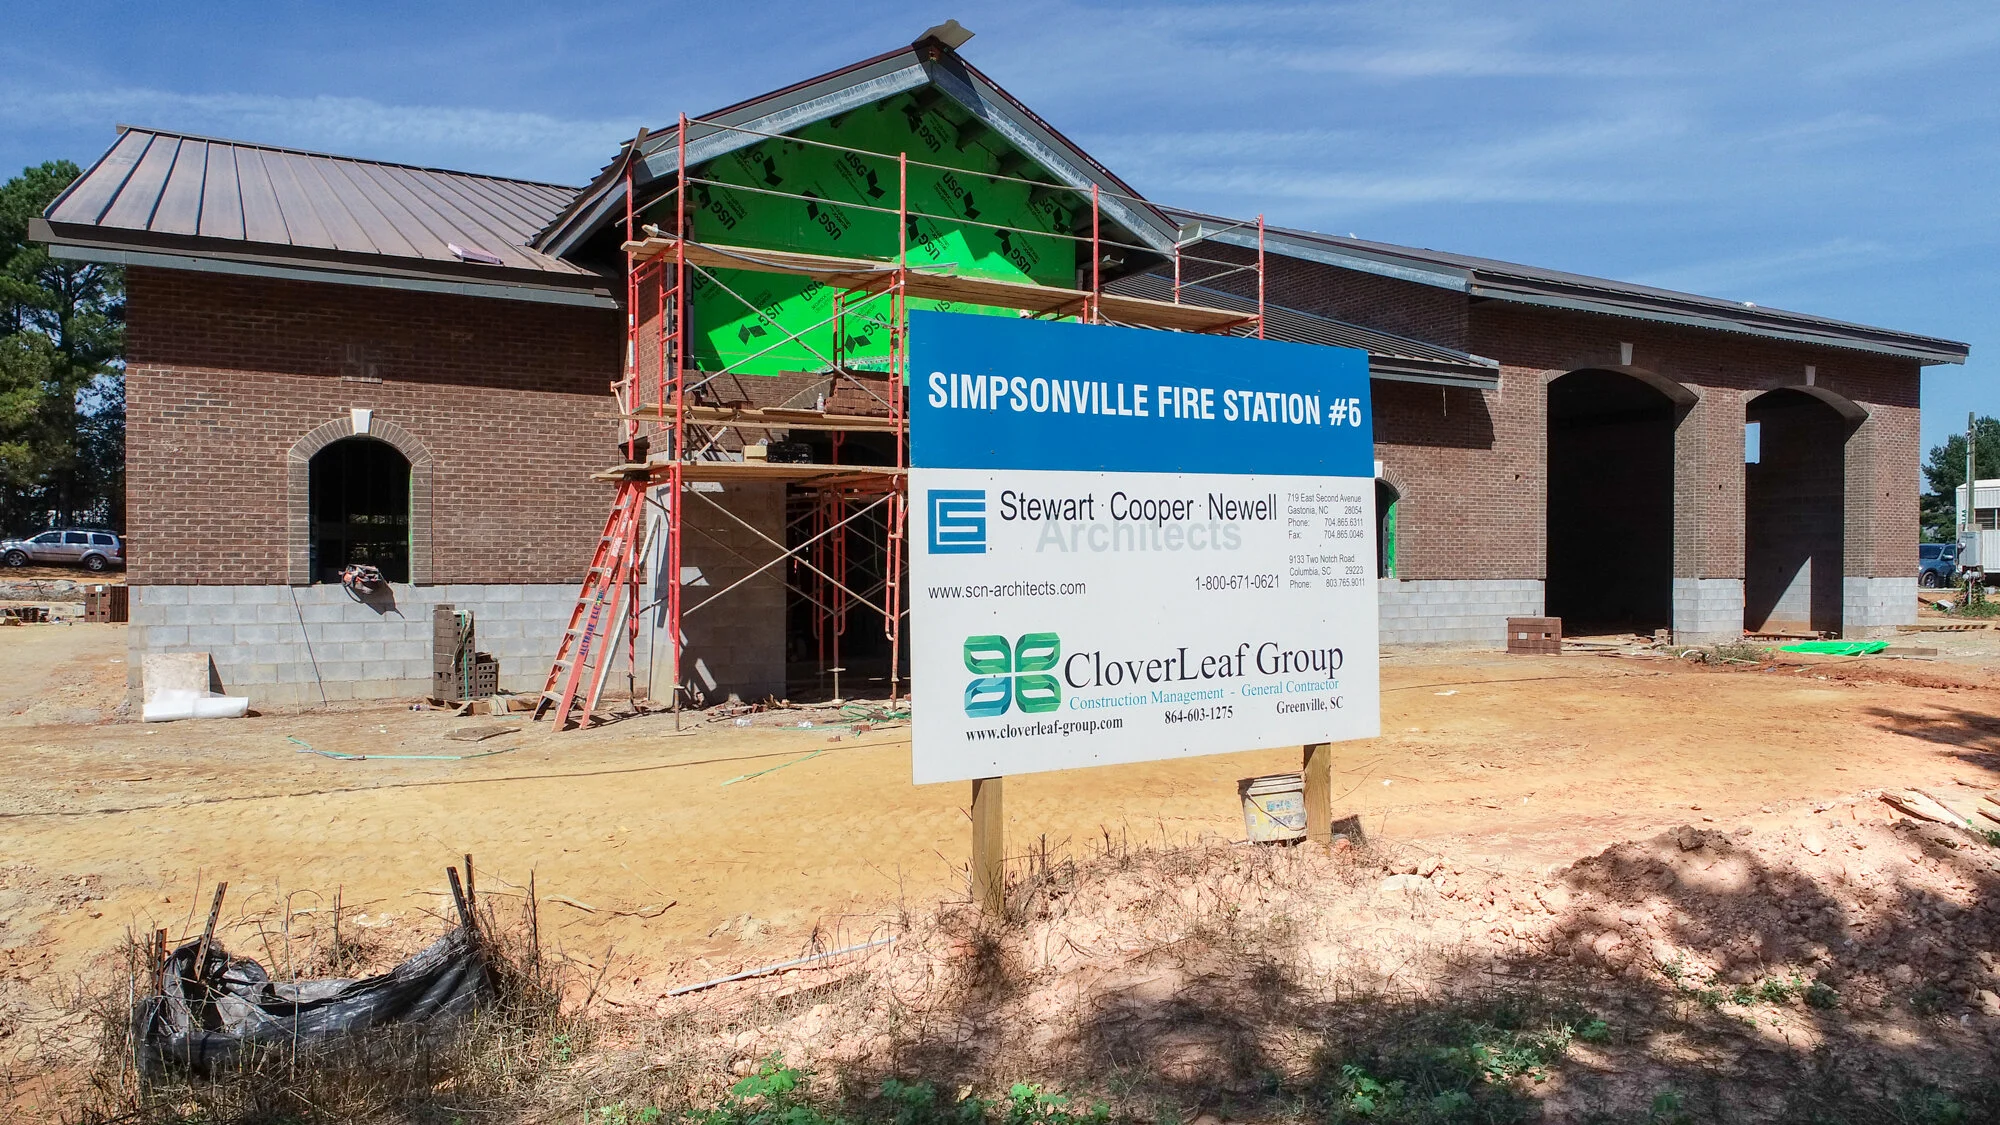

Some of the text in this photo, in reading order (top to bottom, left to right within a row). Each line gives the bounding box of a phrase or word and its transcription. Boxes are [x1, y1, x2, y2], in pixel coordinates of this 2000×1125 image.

[919, 124, 941, 153] USG
[844, 151, 867, 177] USG
[942, 171, 964, 200] USG
[710, 201, 736, 231] USG
[818, 212, 842, 241] USG
[918, 232, 941, 261] USG
[1011, 248, 1031, 274] USG
[800, 280, 825, 302] USG
[757, 301, 784, 327] USG
[862, 312, 887, 337] USG
[928, 371, 1149, 417] SIMPSONVILLE
[1158, 385, 1215, 420] FIRE
[1223, 390, 1321, 425] STATION
[1000, 490, 1277, 528] Stewart Cooper Newell
[1287, 493, 1362, 502] 719 East Second Avenue
[1287, 505, 1362, 515] Gastonia, NC 28054
[1035, 515, 1242, 553] Architects
[1288, 517, 1363, 527] Phone: 704.865.6311
[1324, 529, 1364, 539] 704.865.0046
[1289, 553, 1355, 564] 9133 Two Notch Road
[1289, 565, 1364, 576] Columbia, SC 29223
[928, 581, 1086, 599] www.scn-architects.com
[1195, 574, 1280, 590] 1-800-671-0621
[1289, 577, 1365, 588] Phone: 803.765.9011
[1064, 641, 1344, 689] CloverLeaf Group
[1069, 692, 1147, 711] Construction
[1150, 687, 1224, 705] Management
[1241, 681, 1283, 697] General
[1286, 679, 1340, 693] Contractor
[1276, 695, 1344, 714] Greenville, SC
[1164, 705, 1233, 725] 864-603-1275
[966, 717, 1123, 742] www.cloverleaf-group.com
